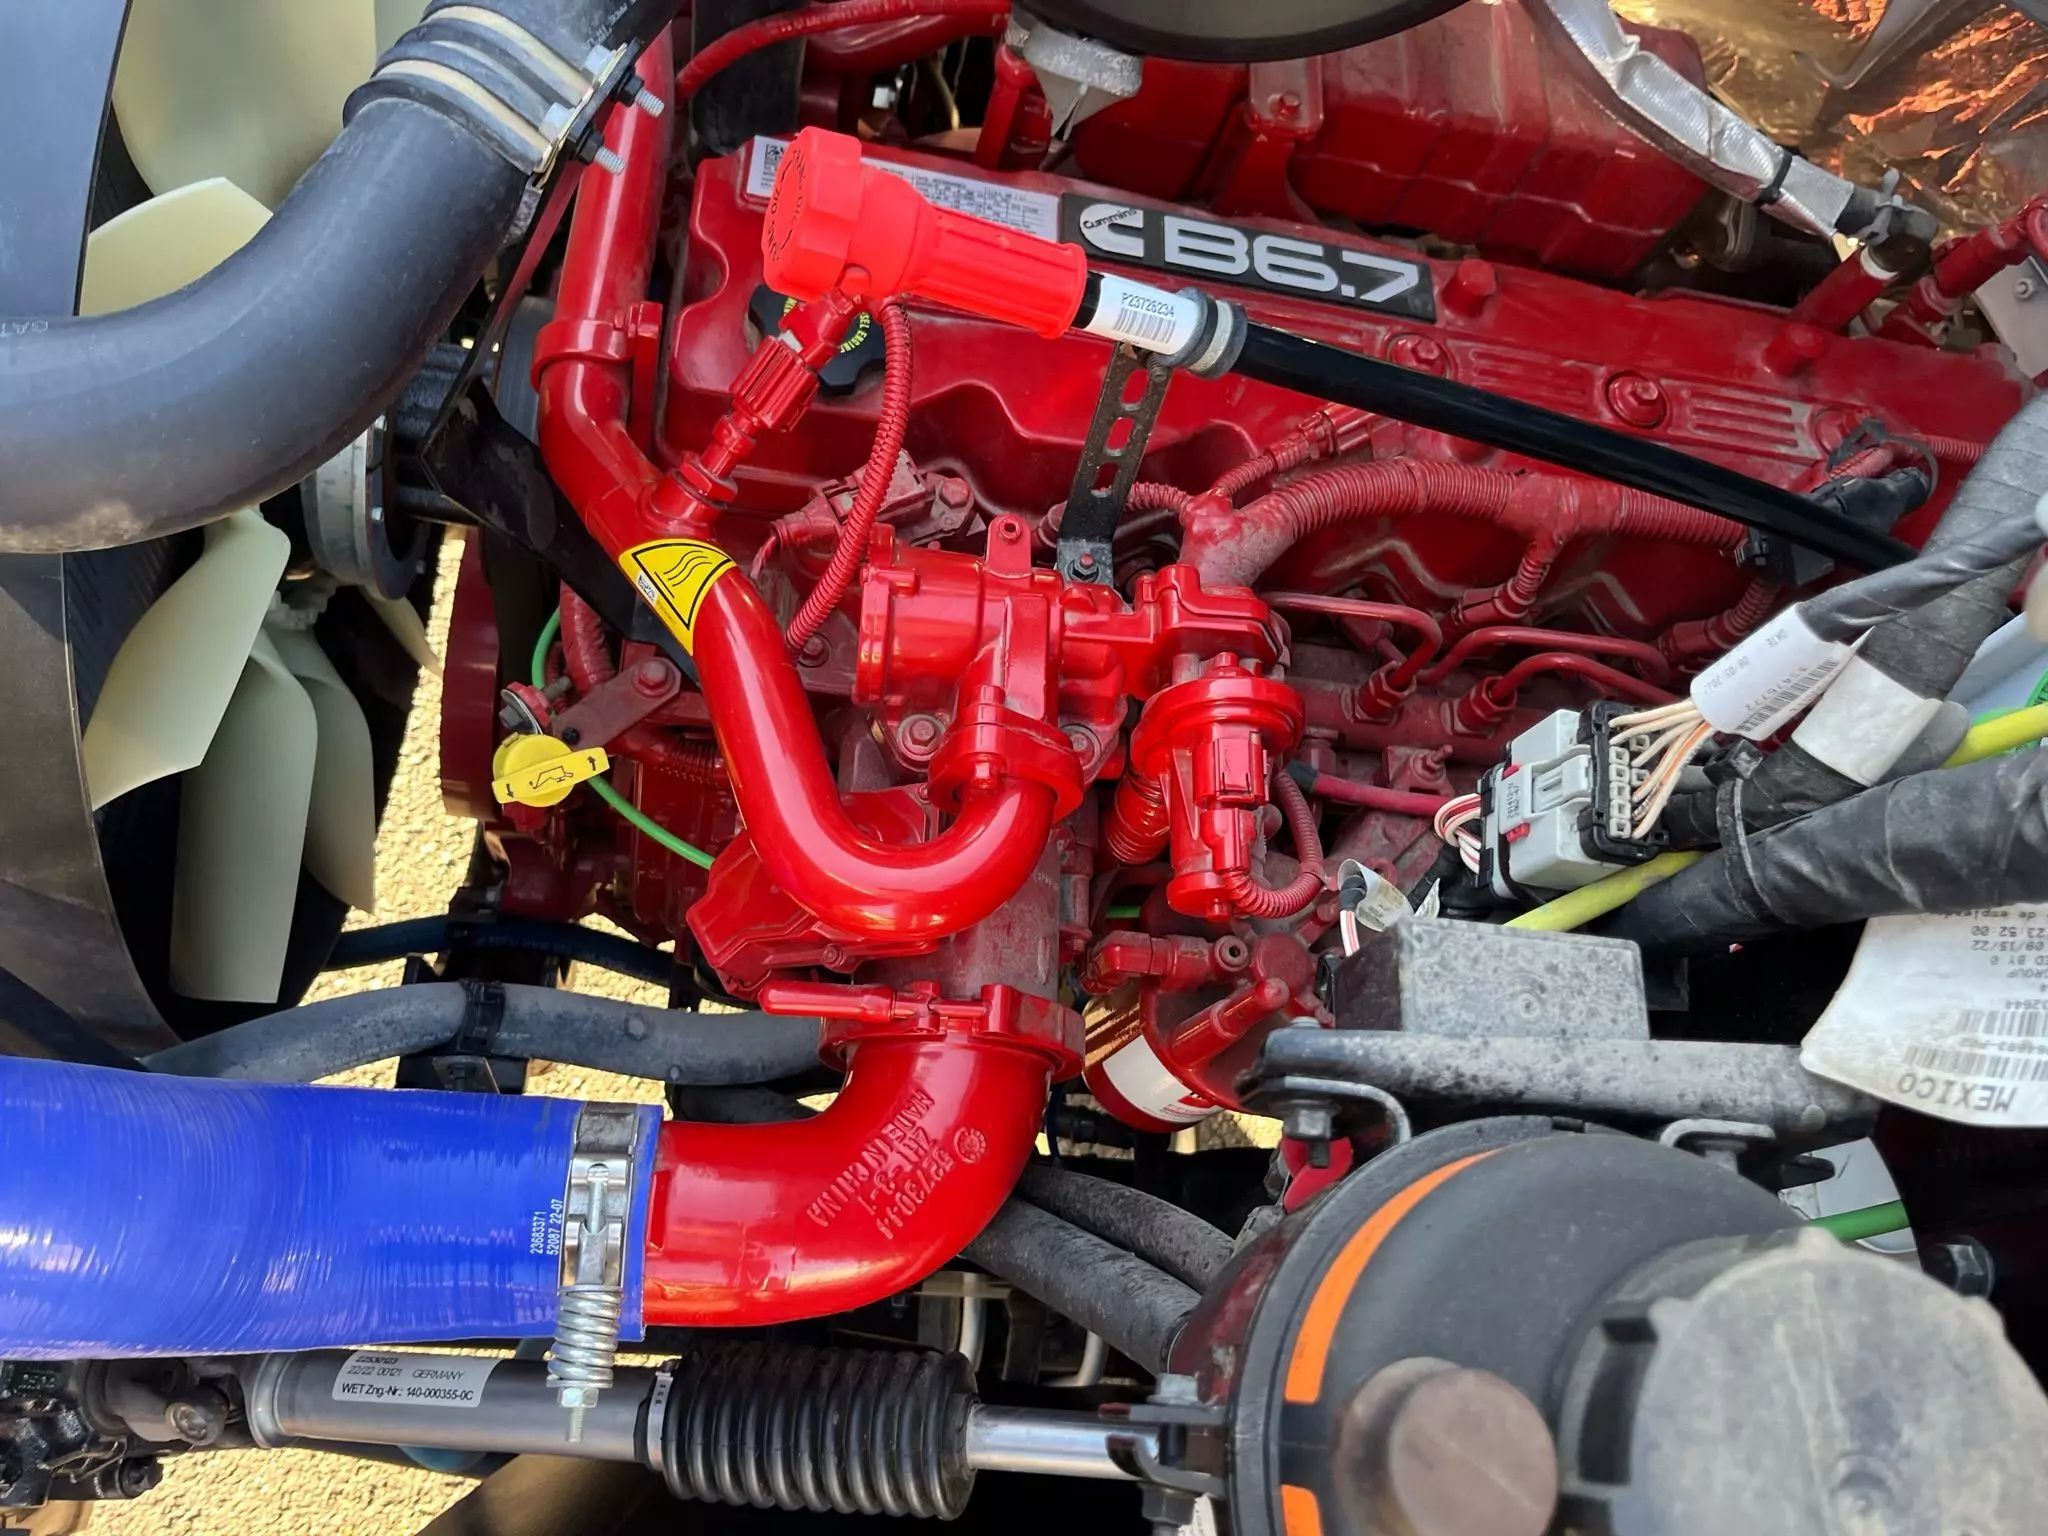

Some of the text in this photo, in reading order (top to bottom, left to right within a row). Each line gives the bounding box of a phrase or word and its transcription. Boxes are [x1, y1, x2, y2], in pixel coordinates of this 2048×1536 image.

[1083, 208, 1138, 230] Cummins
[1163, 214, 1421, 304] B6.7
[1897, 1071, 2018, 1113] MEXICO
[806, 1161, 871, 1228] CHINA
[529, 1211, 547, 1255] 23683371
[546, 1198, 564, 1256] 52087 22-07
[342, 1383, 366, 1394] WET
[412, 1368, 467, 1381] GERMANY
